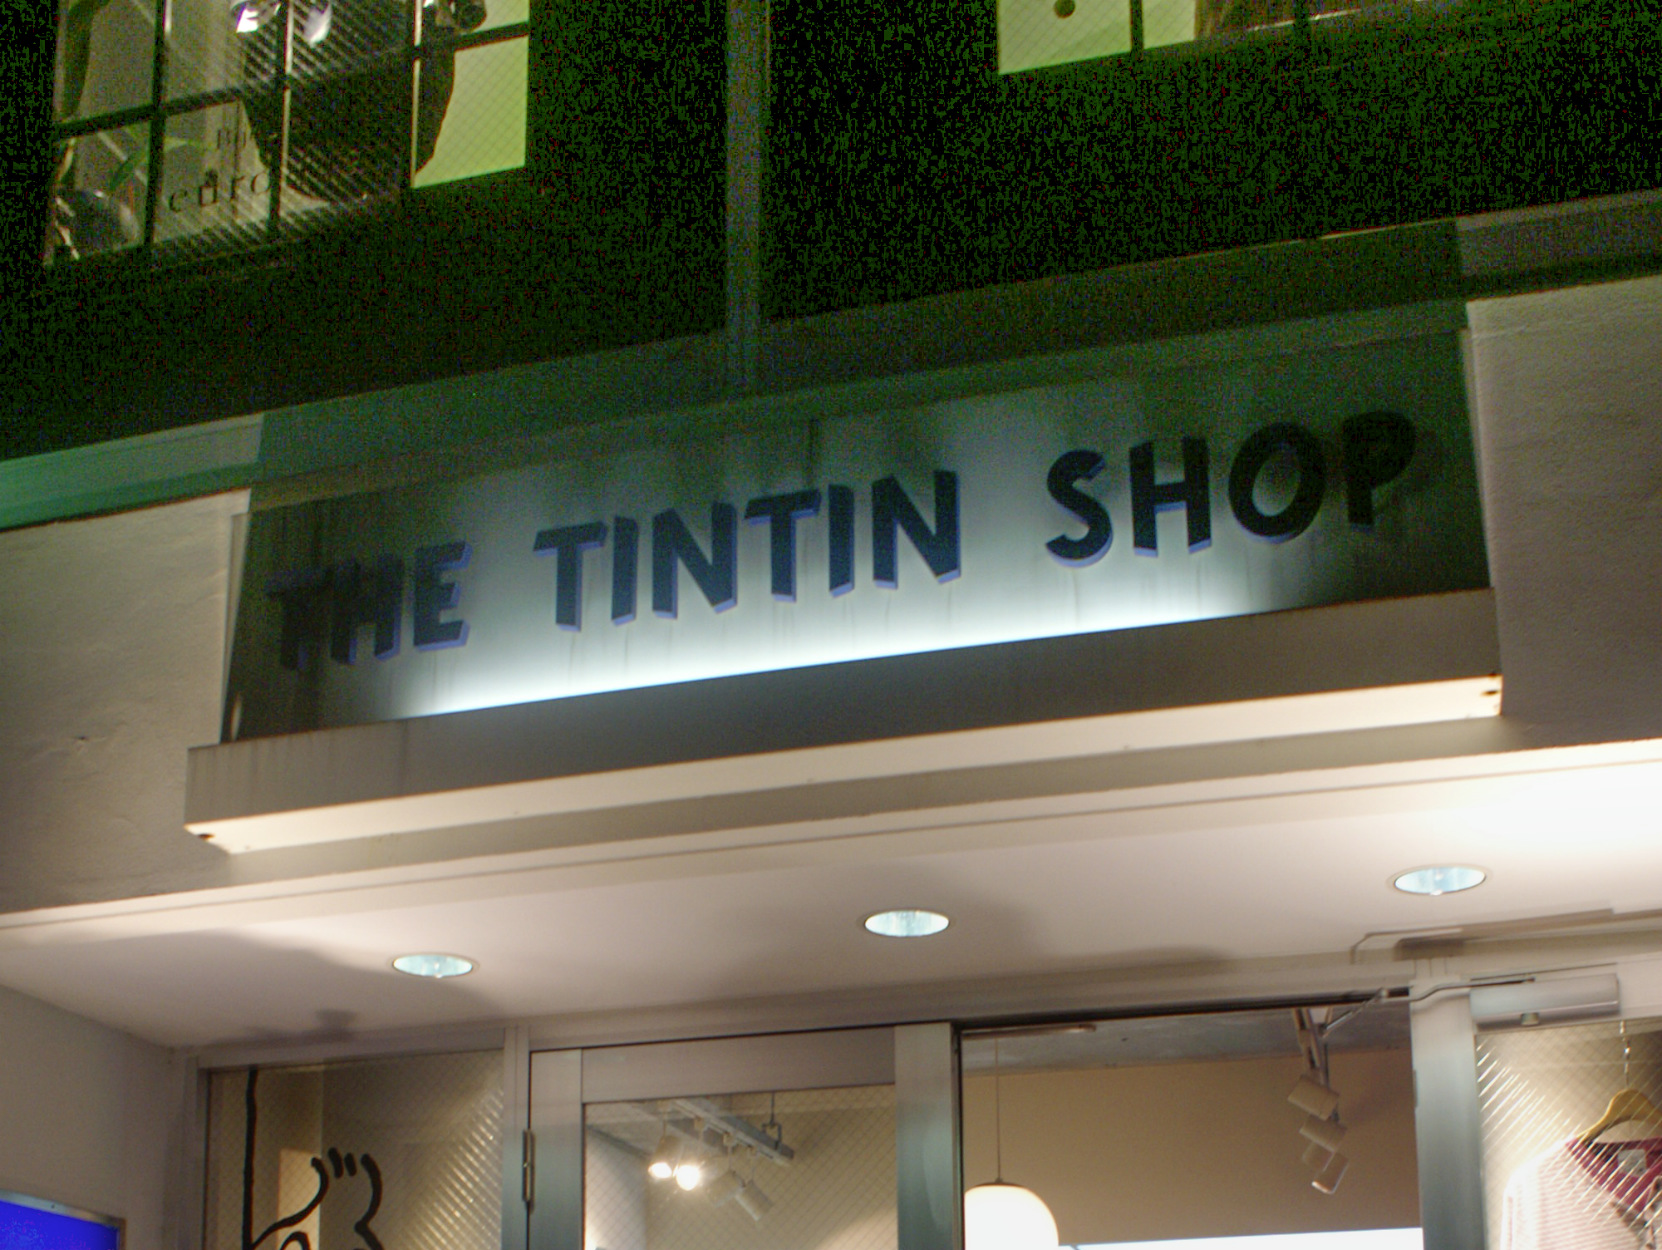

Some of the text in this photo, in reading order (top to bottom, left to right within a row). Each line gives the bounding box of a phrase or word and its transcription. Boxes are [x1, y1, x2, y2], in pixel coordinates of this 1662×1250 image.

[265, 410, 1415, 670] THE TINTIN SHOP
